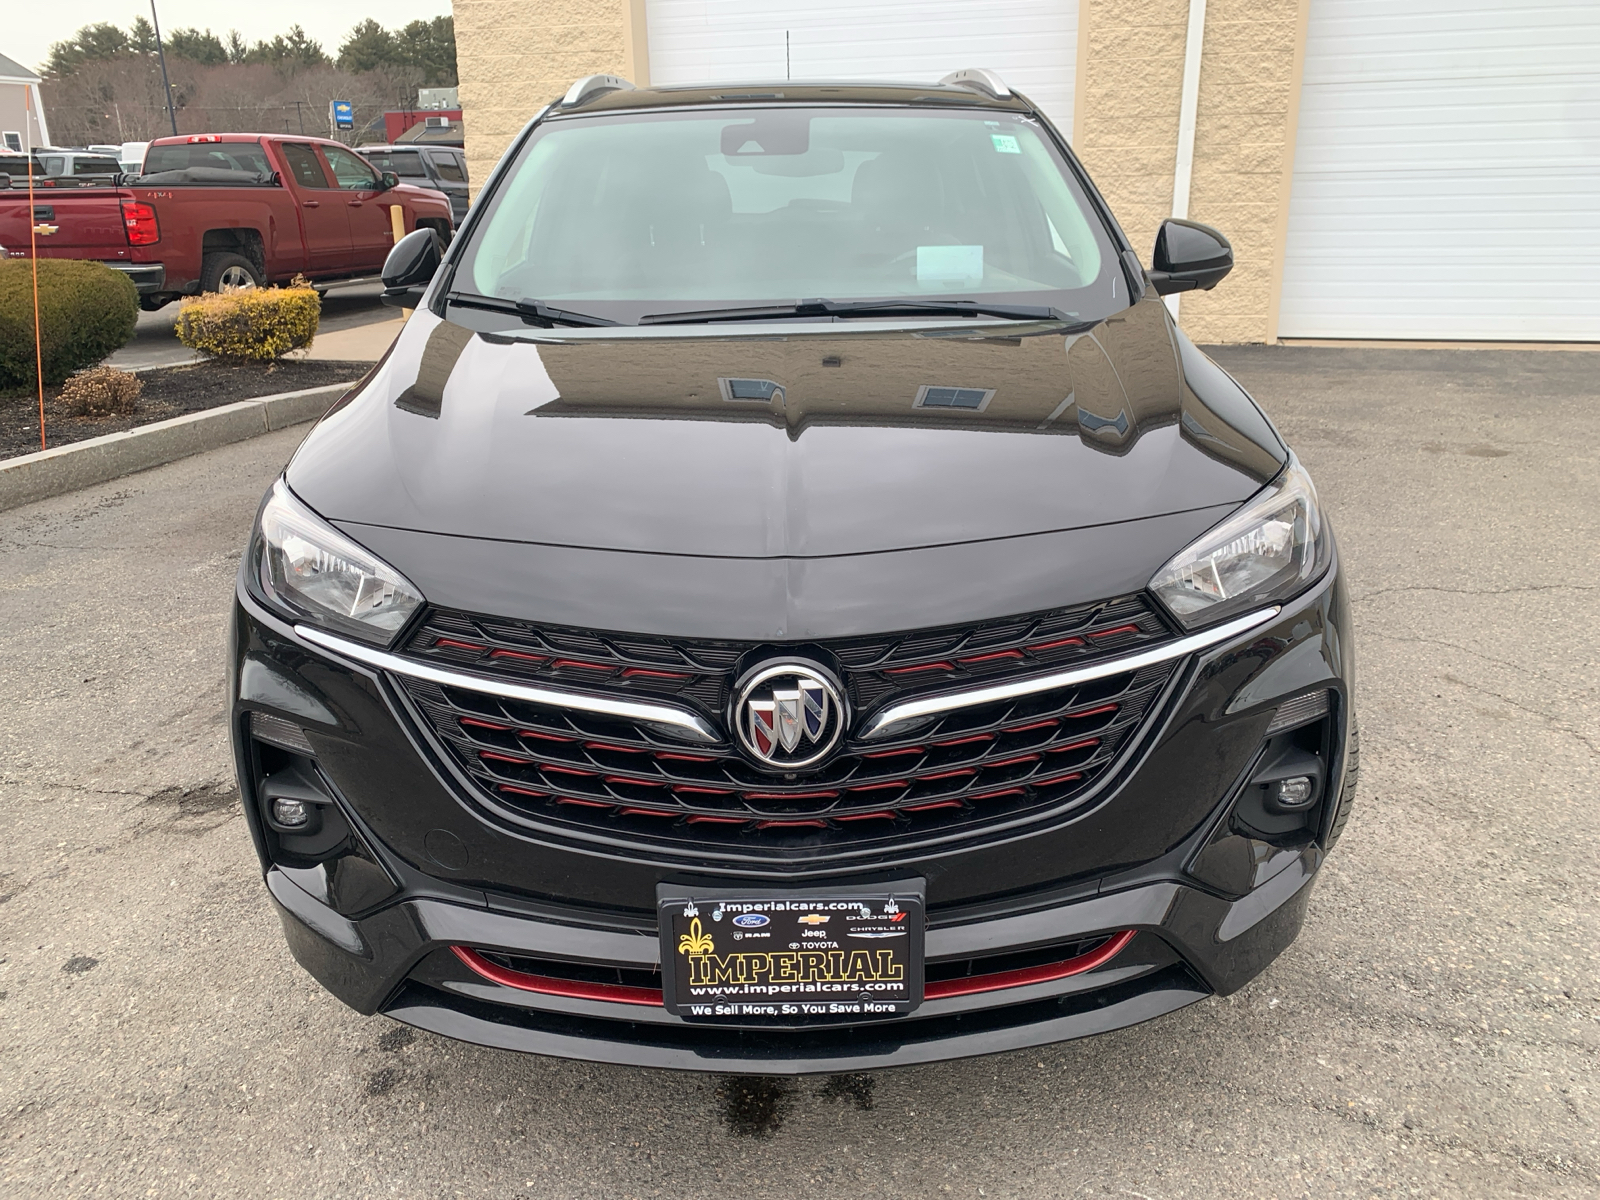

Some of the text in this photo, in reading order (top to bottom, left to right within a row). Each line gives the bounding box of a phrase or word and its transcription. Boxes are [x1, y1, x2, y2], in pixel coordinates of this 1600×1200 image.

[719, 901, 864, 913] Imperialcars.com
[740, 916, 762, 926] Ford
[801, 929, 826, 939] Jeep
[801, 941, 839, 949] TOYOTA
[688, 949, 903, 985] IMPERIAL
[690, 982, 904, 996] www.imperialcars.com
[691, 1003, 896, 1016] We Sell More, So You Save More
